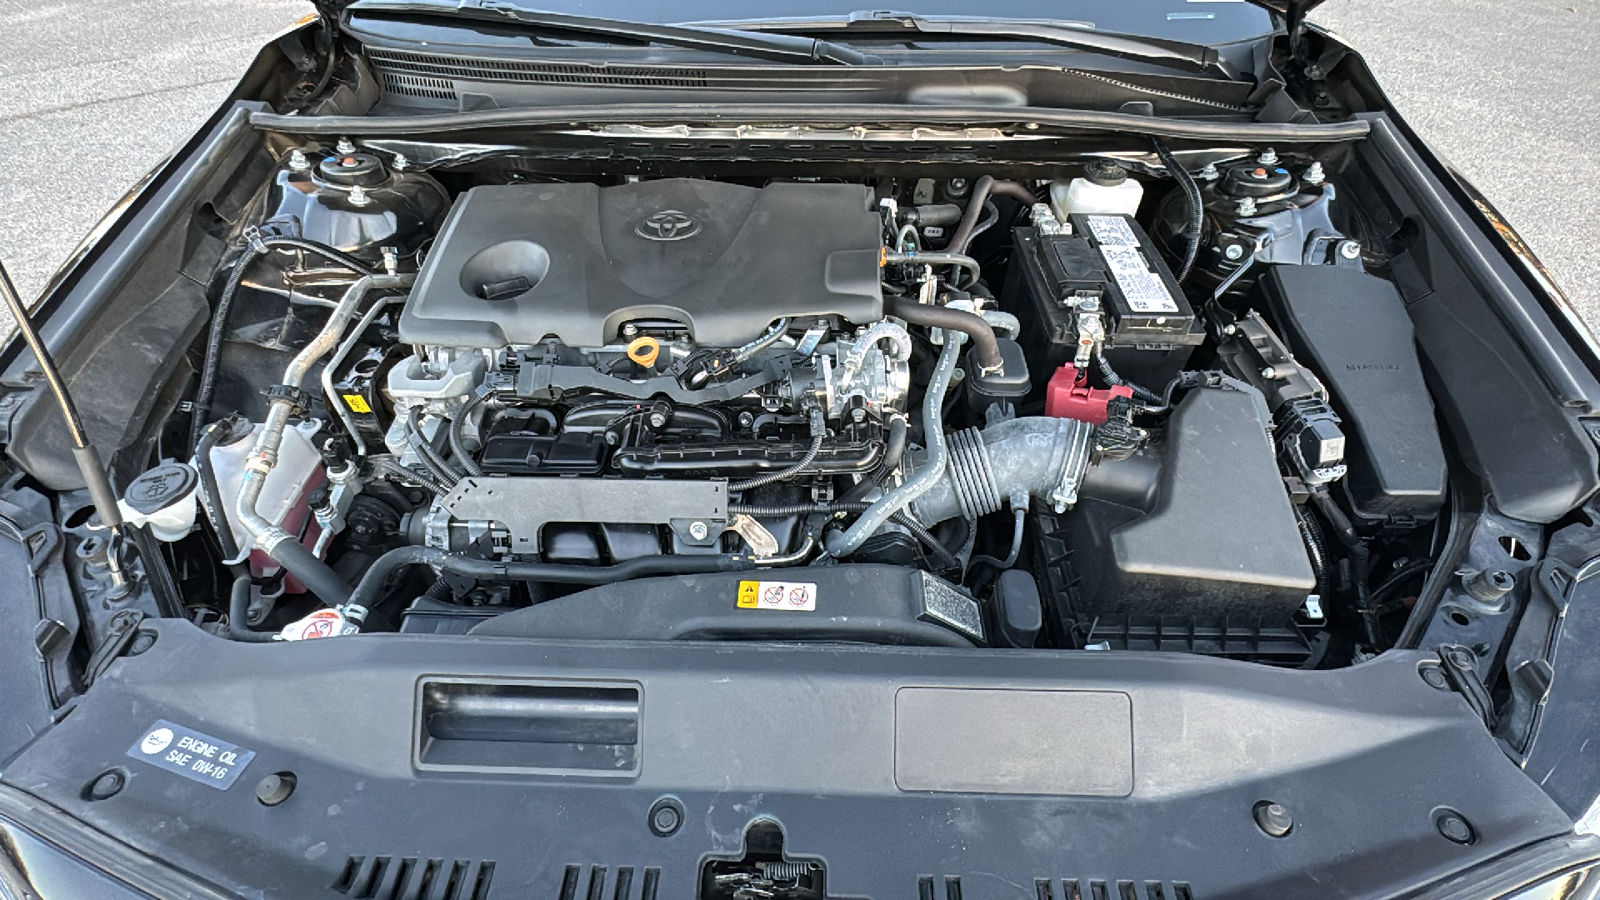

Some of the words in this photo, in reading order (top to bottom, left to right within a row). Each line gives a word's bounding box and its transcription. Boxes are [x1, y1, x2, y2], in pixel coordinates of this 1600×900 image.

[165, 750, 193, 766] SAE
[192, 759, 229, 779] 0W-16
[177, 736, 219, 758] ENGINE
[219, 751, 239, 766] OIL
